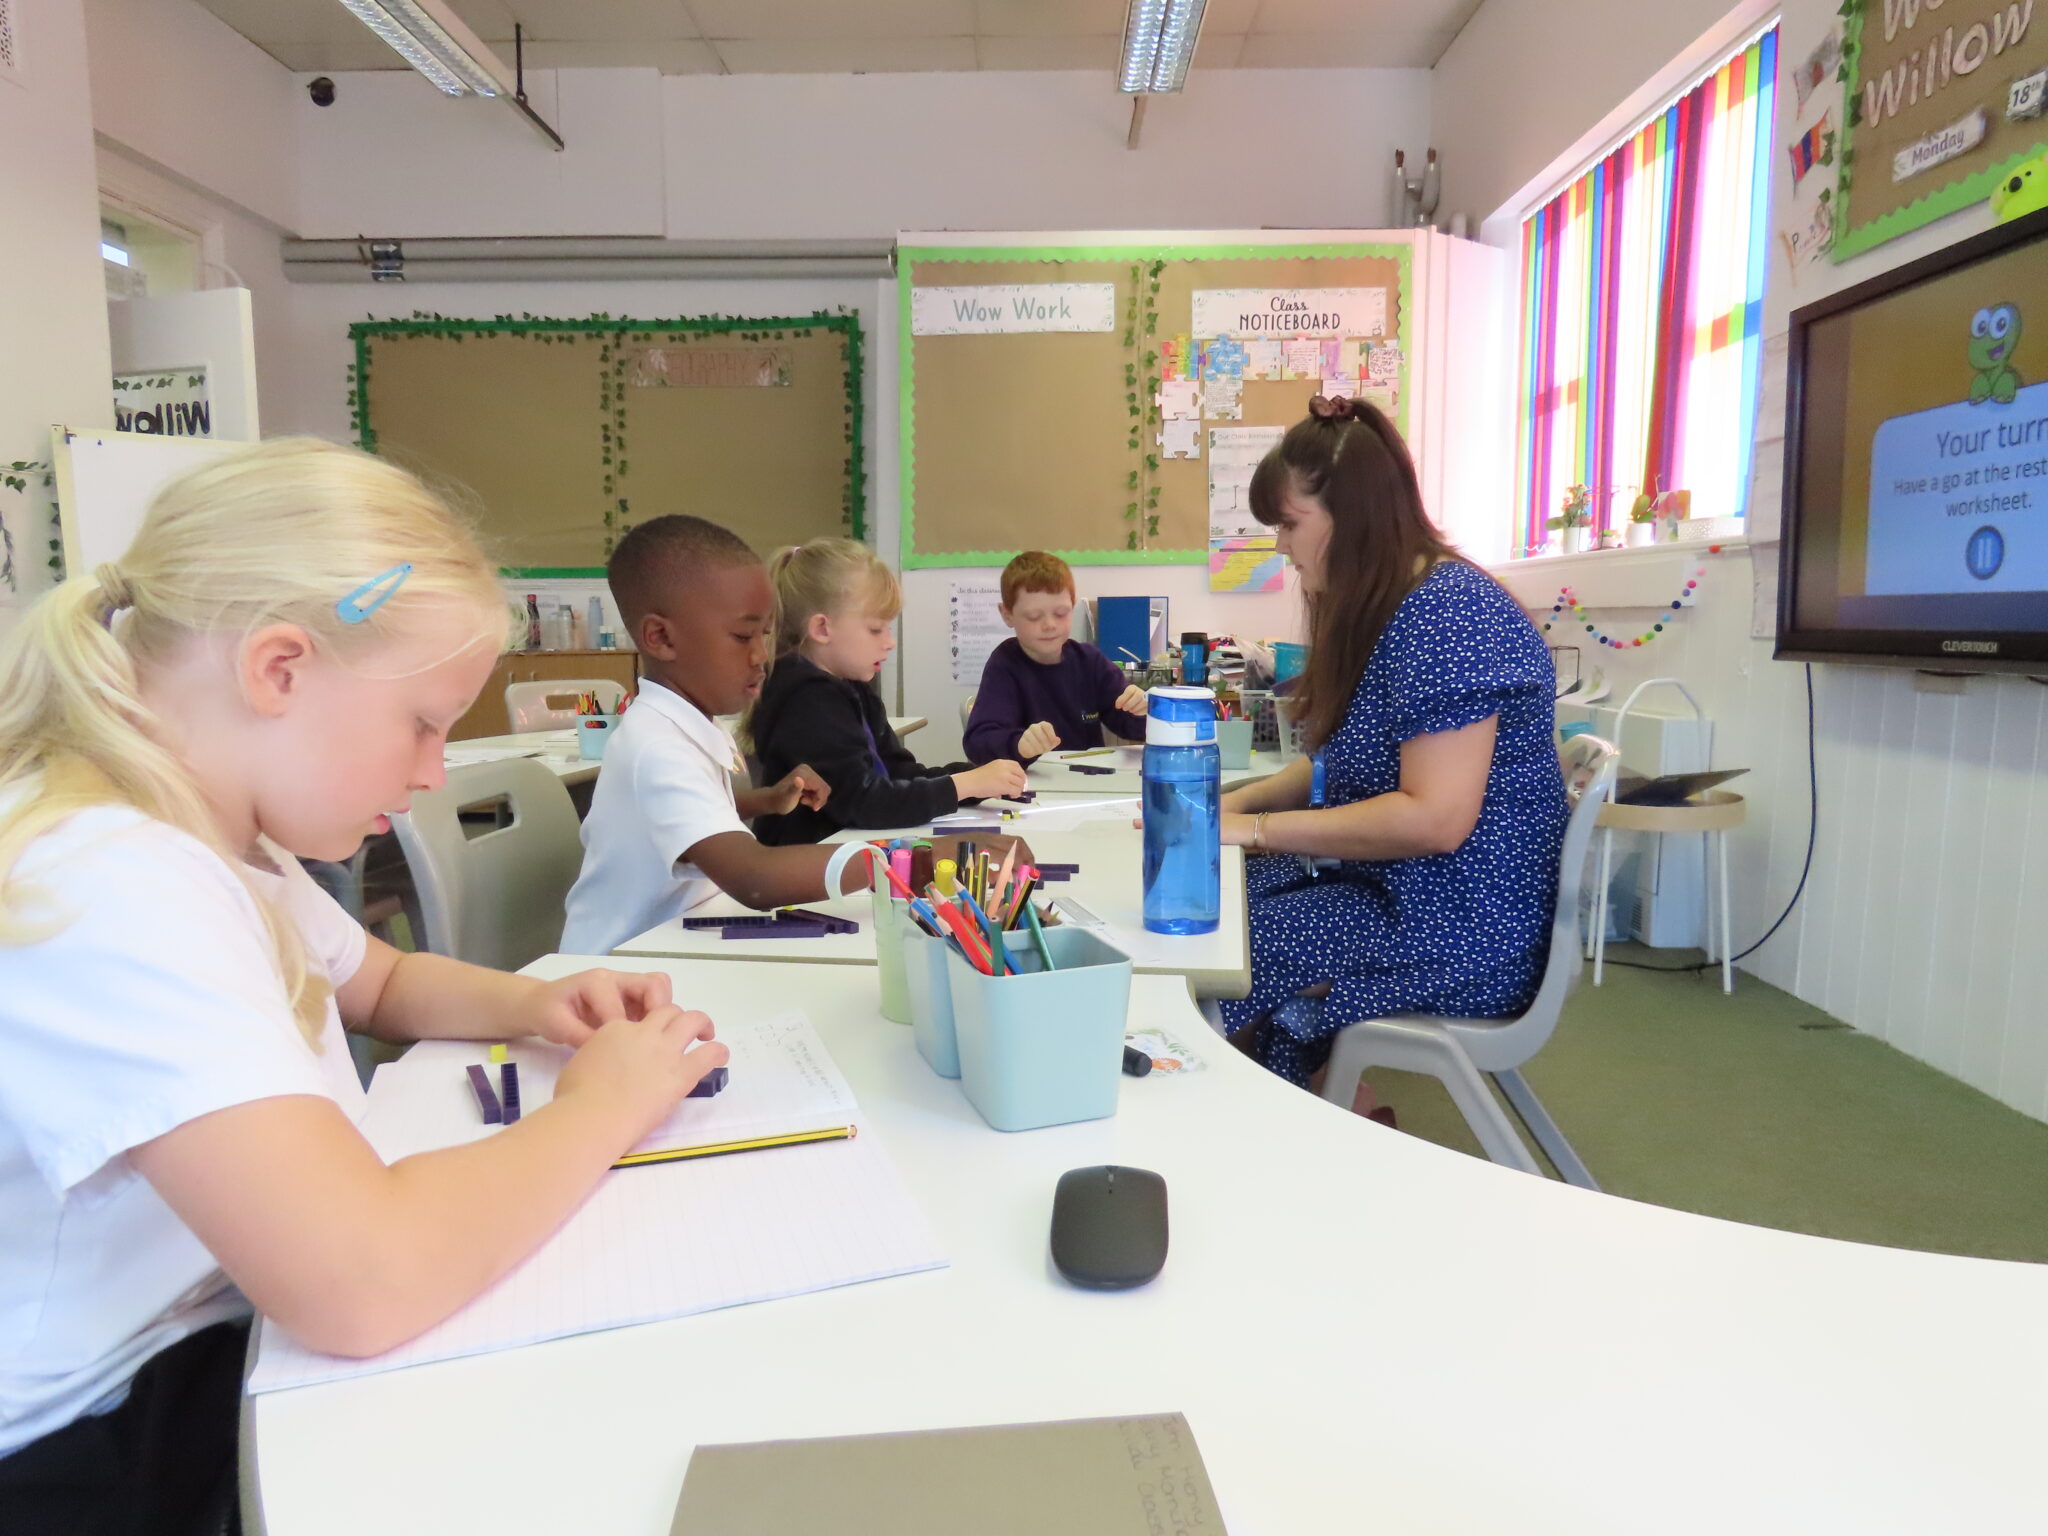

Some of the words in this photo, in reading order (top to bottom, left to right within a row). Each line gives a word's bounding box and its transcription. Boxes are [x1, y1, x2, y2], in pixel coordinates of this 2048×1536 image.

[1866, 0, 2033, 128] Willow
[1911, 131, 1965, 166] Monday
[953, 298, 1002, 322] Wow
[1012, 296, 1072, 320] Work
[1270, 296, 1309, 312] Class
[1239, 313, 1341, 331] NOTICEBOARD
[1936, 429, 1991, 458] Your
[1893, 477, 1927, 496] Have
[1930, 477, 1938, 491] a
[1942, 473, 1960, 494] go
[1965, 469, 1979, 487] at
[1984, 463, 2010, 484] the
[2015, 458, 2048, 479] rest
[1946, 491, 2032, 517] worksheet.
